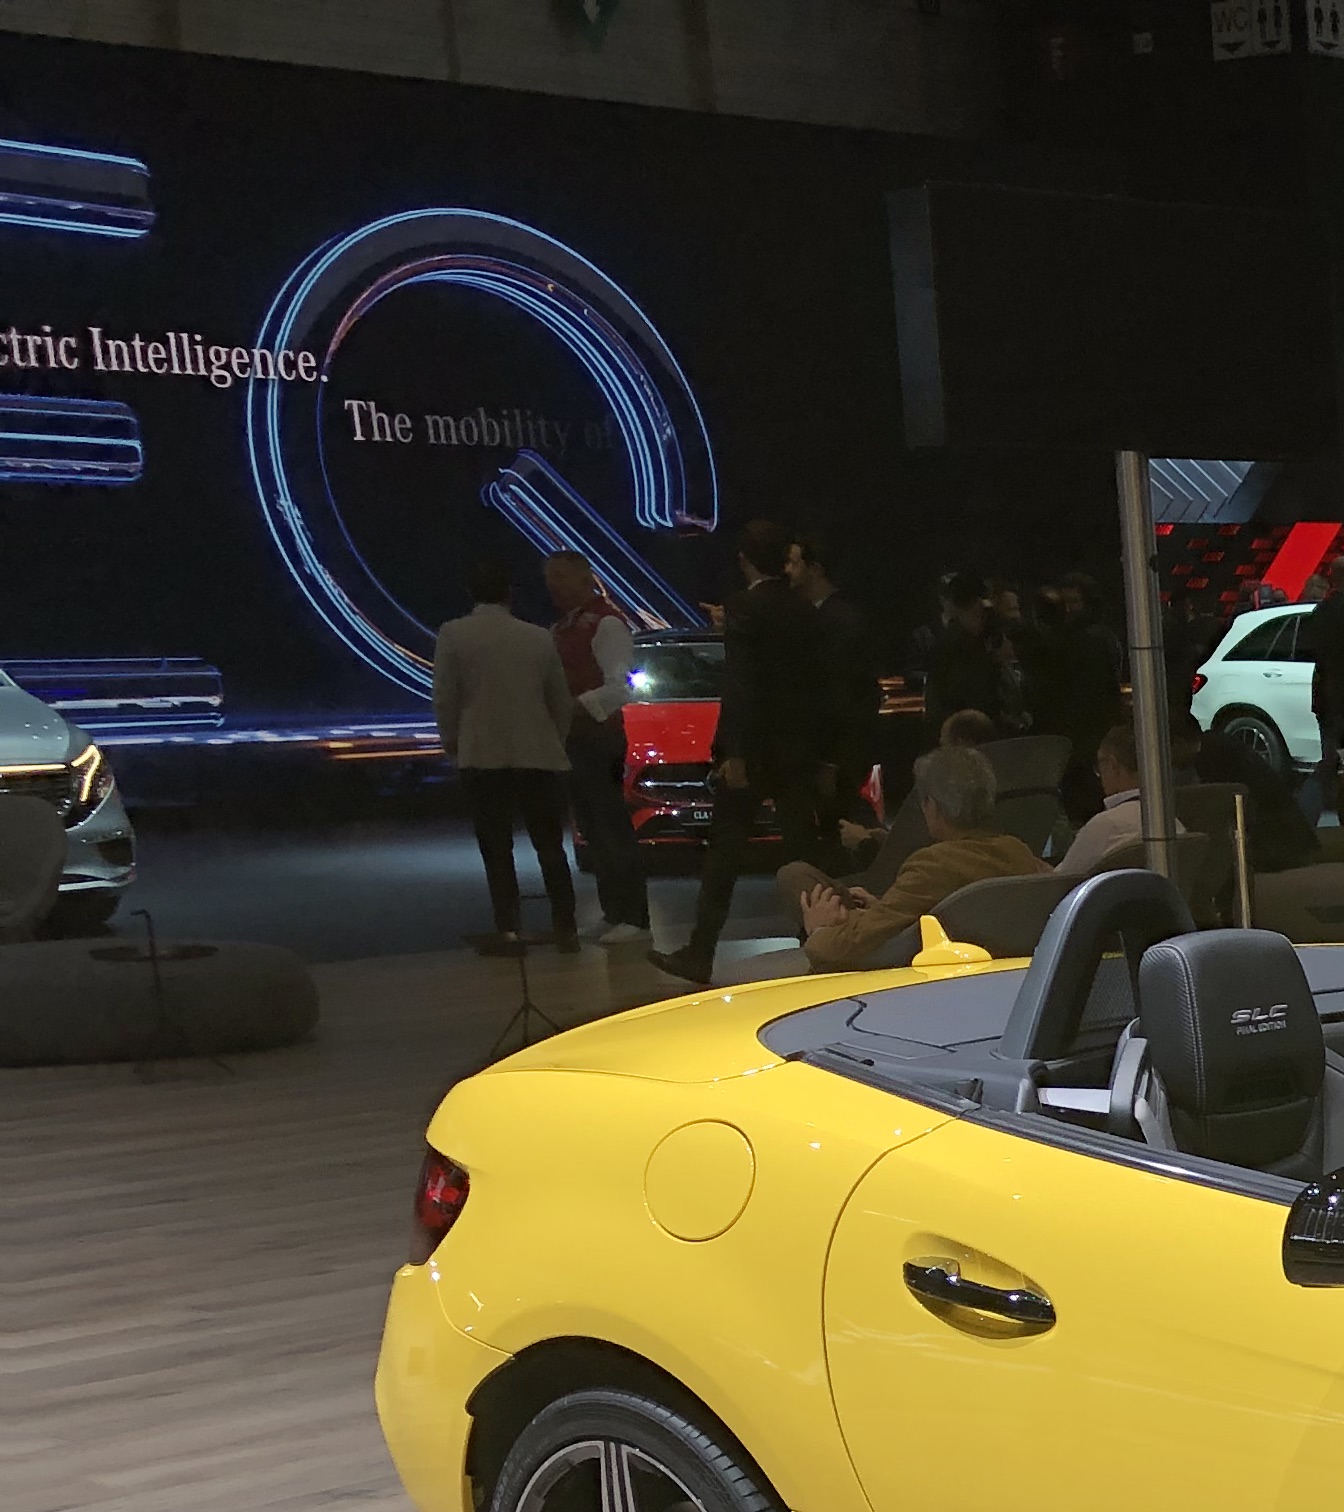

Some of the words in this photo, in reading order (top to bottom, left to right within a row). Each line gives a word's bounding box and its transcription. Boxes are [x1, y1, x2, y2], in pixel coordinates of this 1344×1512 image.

[1216, 7, 1248, 33] WC
[88, 326, 329, 388] Intelligence.
[344, 400, 413, 443] The
[424, 407, 571, 459] mobility
[1231, 1004, 1289, 1024] SLC
